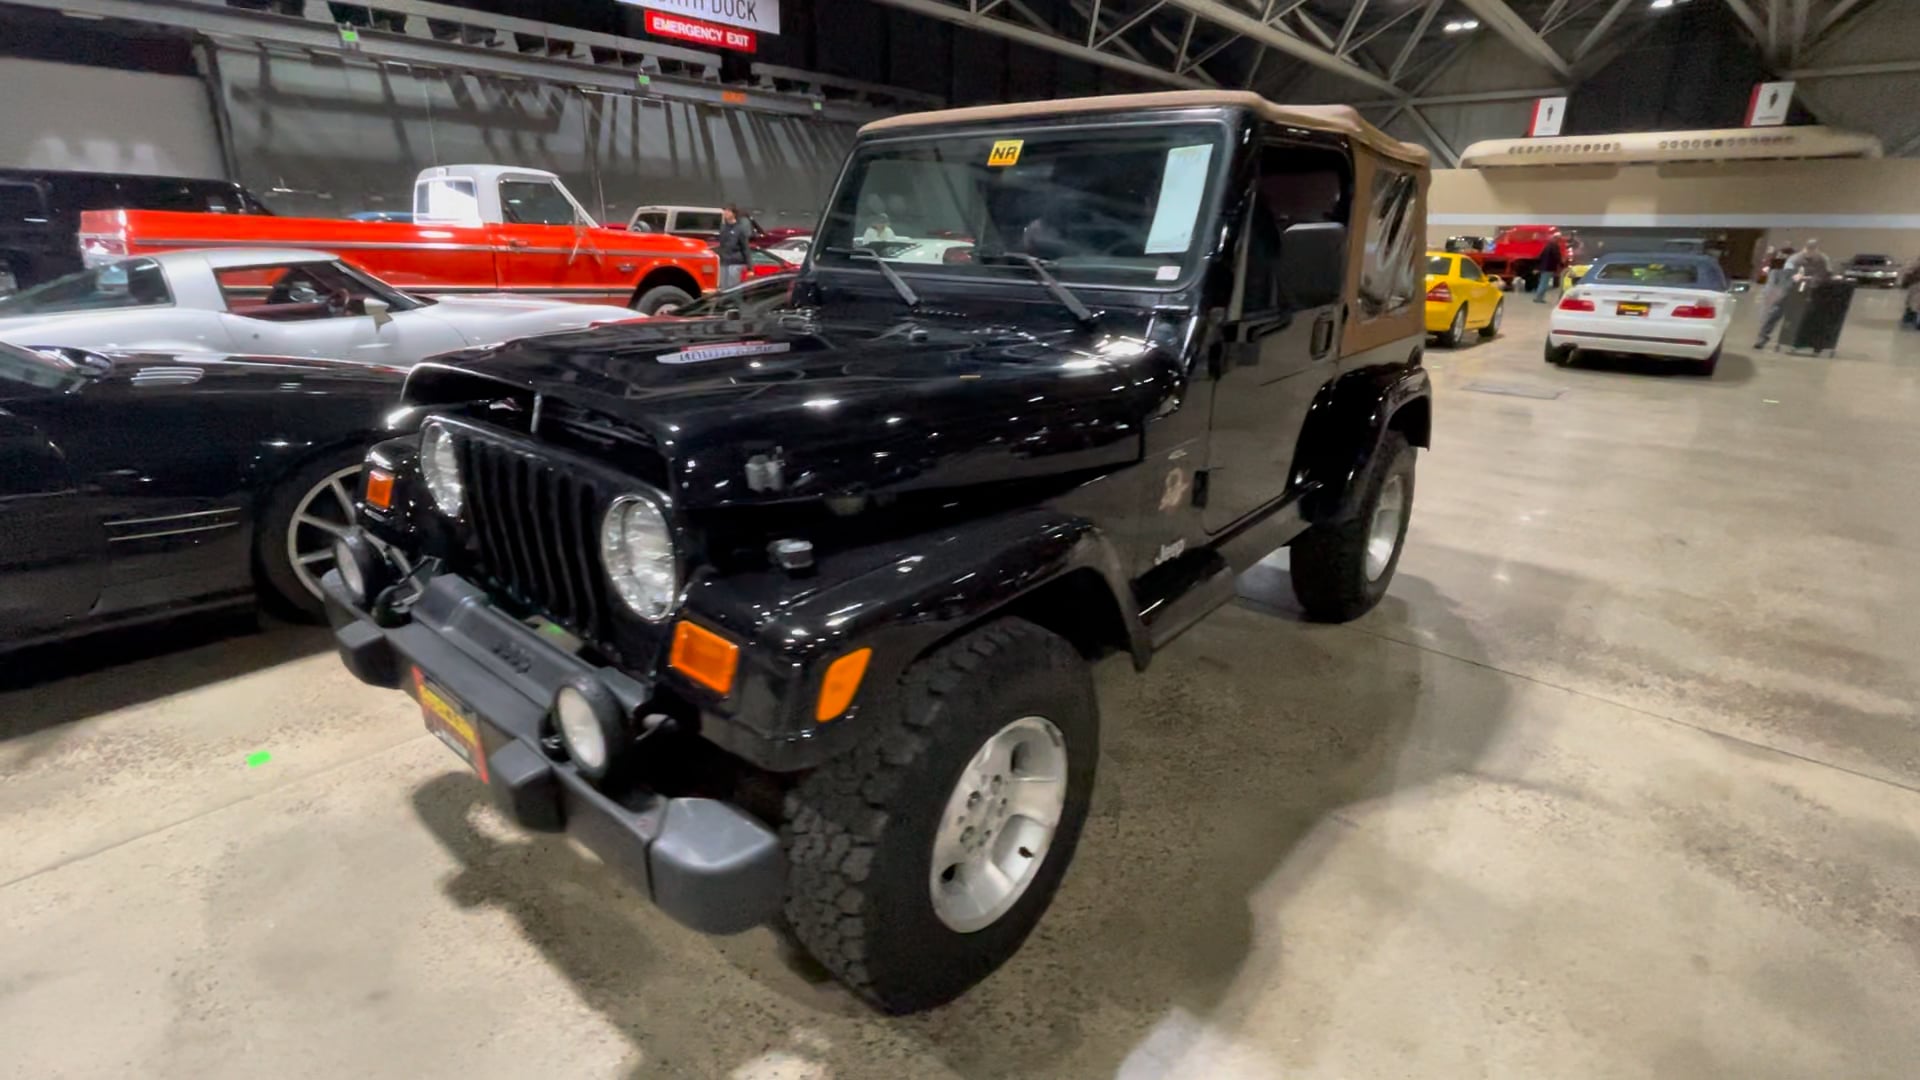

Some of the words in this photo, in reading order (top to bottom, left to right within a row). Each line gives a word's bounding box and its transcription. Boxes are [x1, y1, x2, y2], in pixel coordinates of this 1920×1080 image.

[712, 0, 758, 22] DOCK
[652, 16, 723, 41] EMERGENCY
[726, 32, 750, 47] EXIT
[991, 145, 1019, 160] NR
